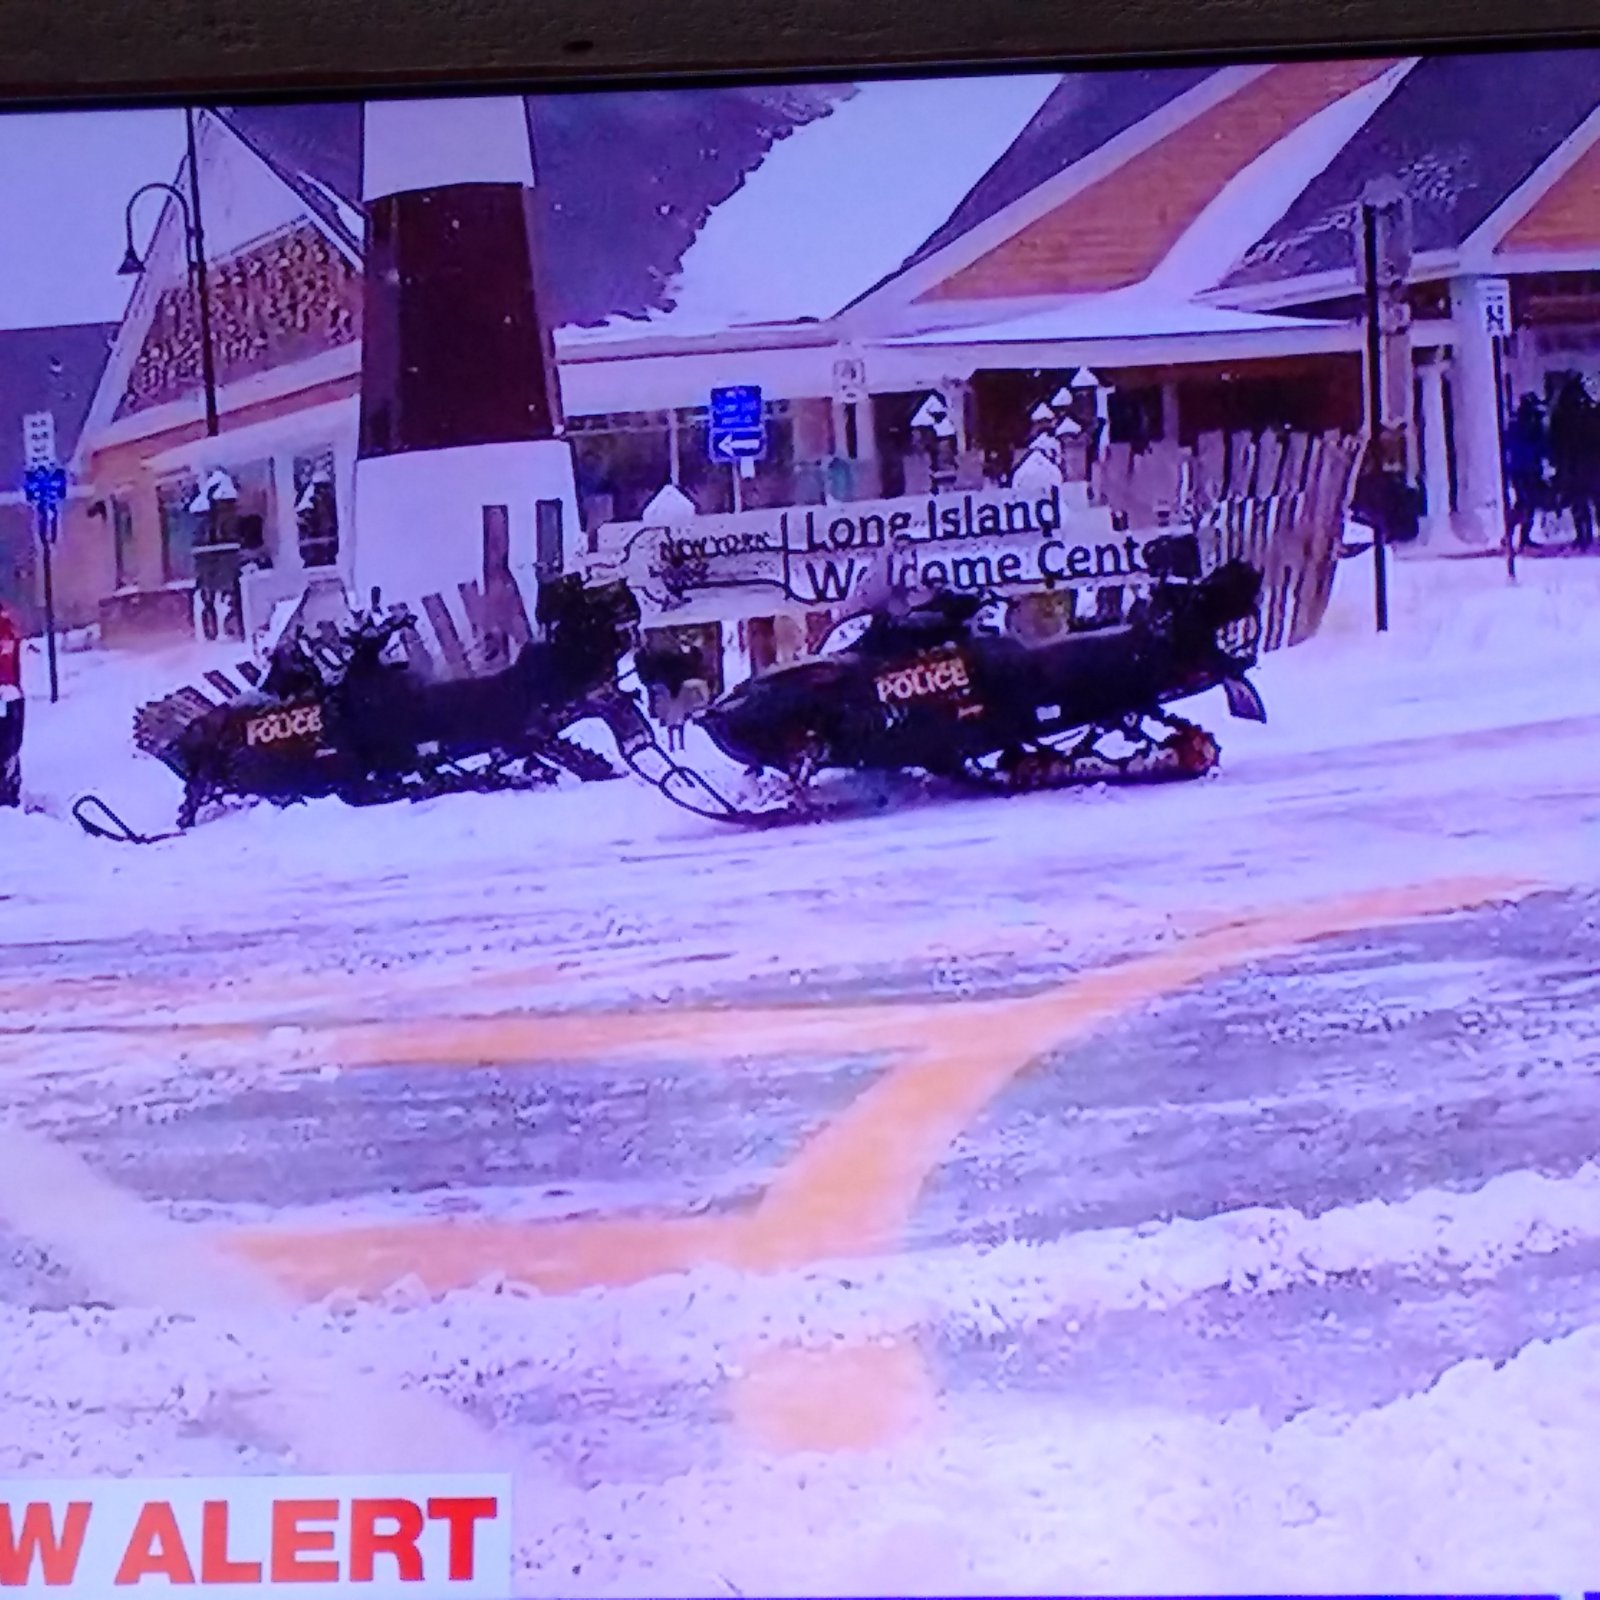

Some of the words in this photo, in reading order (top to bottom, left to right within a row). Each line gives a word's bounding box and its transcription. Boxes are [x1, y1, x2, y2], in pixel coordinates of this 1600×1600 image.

[805, 510, 911, 551] Long
[927, 484, 1061, 542] Island
[874, 658, 970, 703] POLICE
[246, 705, 324, 746] POLICE
[114, 1497, 498, 1586] ALERT
